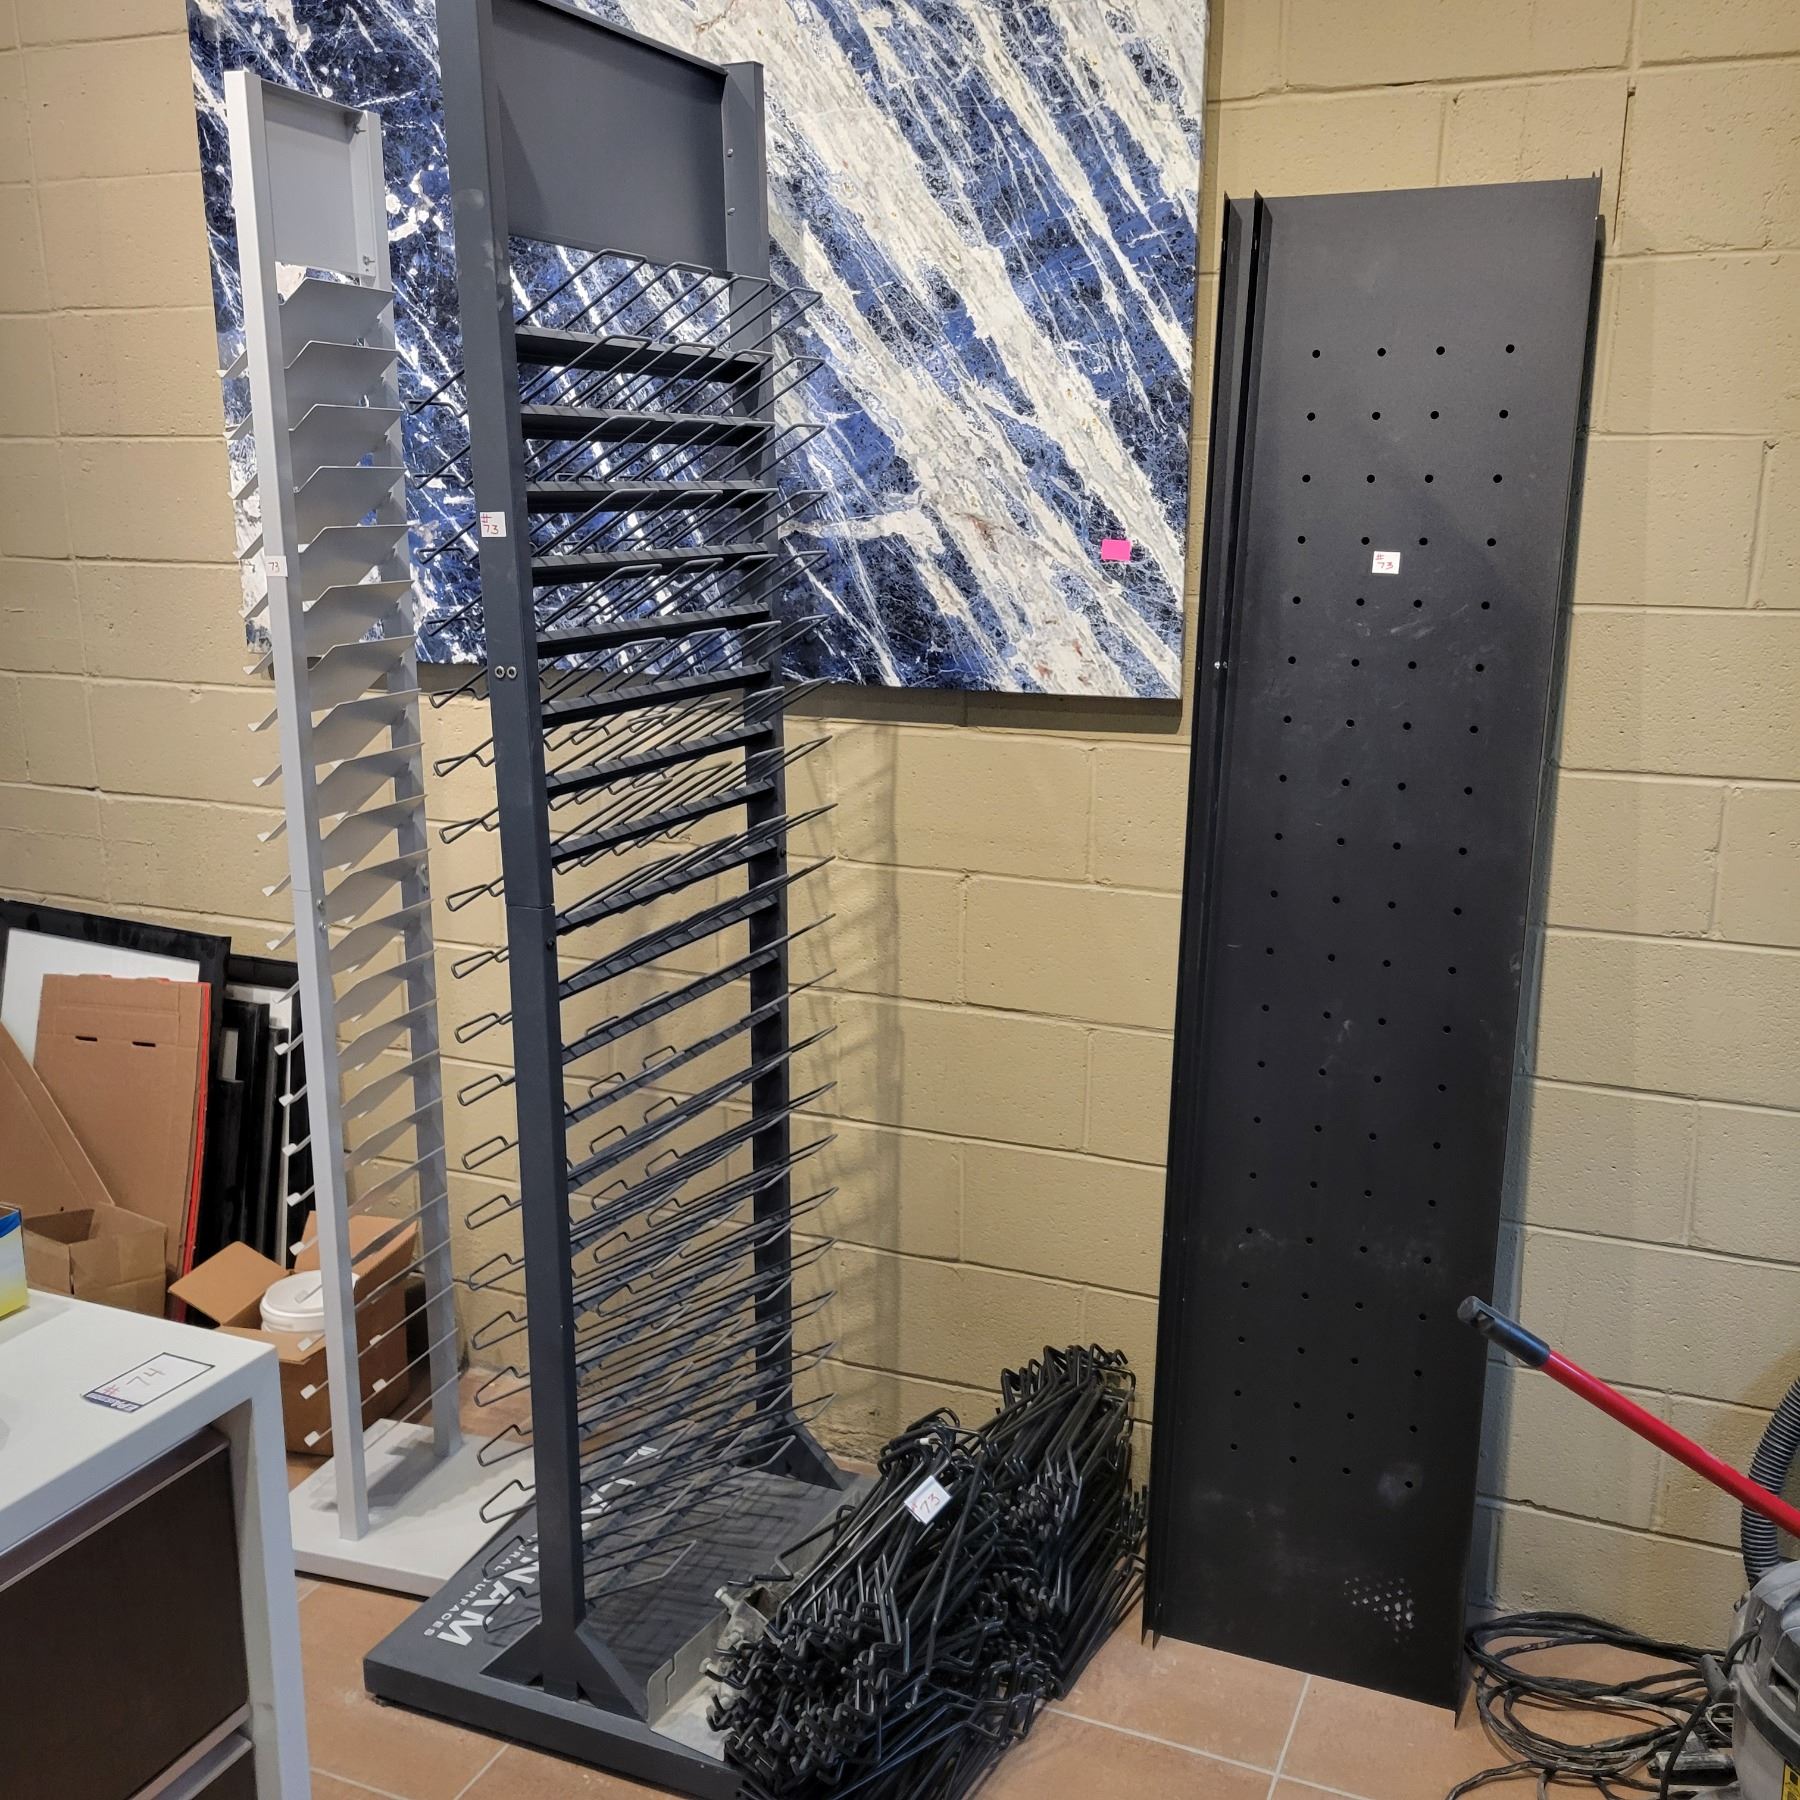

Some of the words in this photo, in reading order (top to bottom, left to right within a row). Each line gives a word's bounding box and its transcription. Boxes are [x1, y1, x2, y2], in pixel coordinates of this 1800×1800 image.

[483, 524, 499, 535] 73
[267, 561, 280, 574] 73
[1377, 561, 1394, 571] 73
[126, 1368, 166, 1386] 74
[919, 1492, 941, 1514] 73
